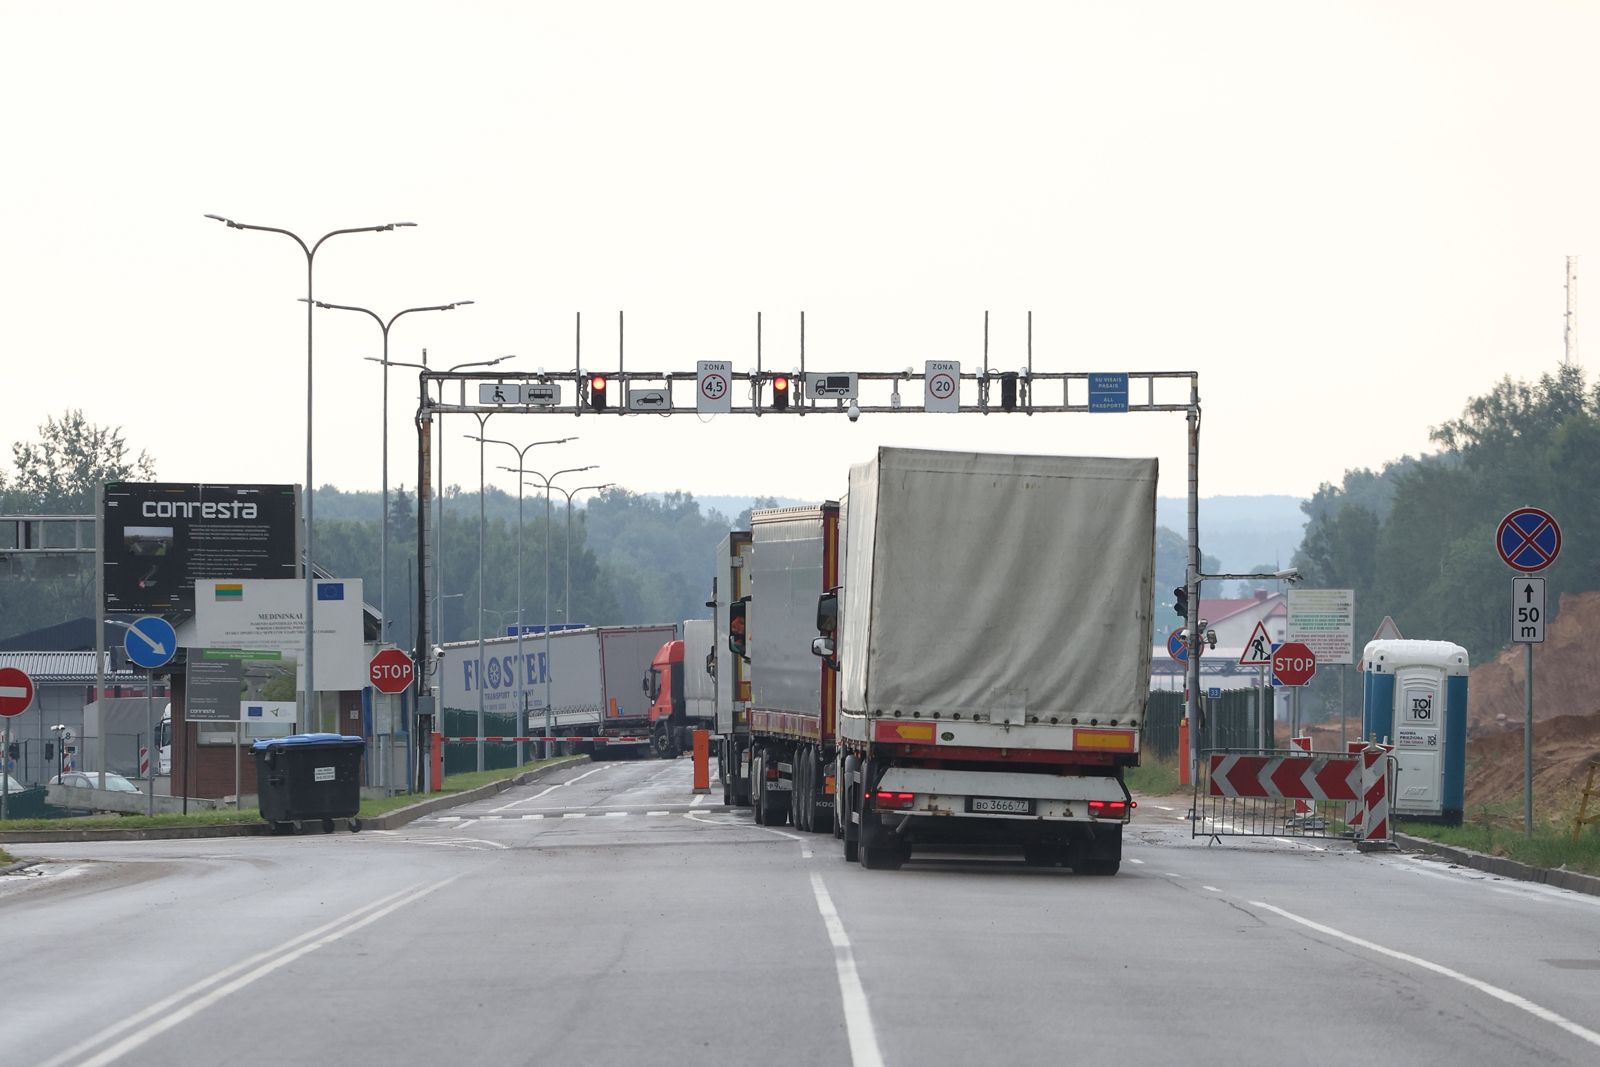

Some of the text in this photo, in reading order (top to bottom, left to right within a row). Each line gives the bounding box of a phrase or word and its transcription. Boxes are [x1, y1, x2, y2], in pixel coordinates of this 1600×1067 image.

[705, 381, 723, 393] 4,5
[935, 381, 950, 392] 20
[142, 500, 258, 519] conresta
[1518, 607, 1540, 623] 50
[1521, 626, 1537, 638] m
[1275, 657, 1314, 672] STOP
[372, 664, 411, 679] STOP
[1412, 695, 1432, 709] TOI
[1412, 709, 1431, 719] TOI
[990, 800, 1014, 811] 3666
